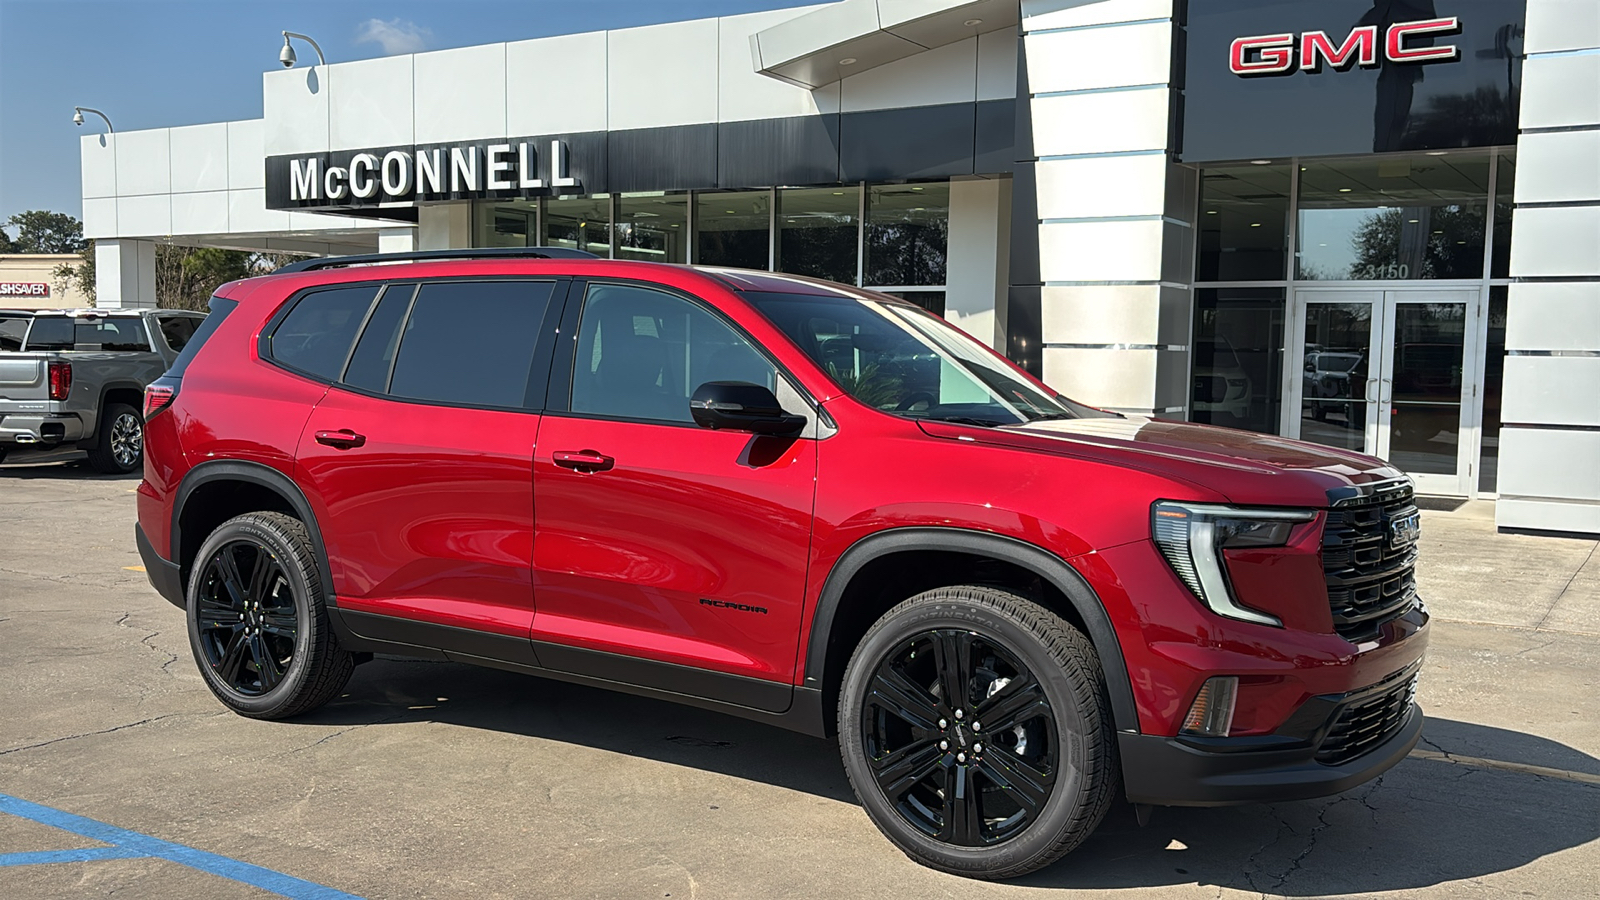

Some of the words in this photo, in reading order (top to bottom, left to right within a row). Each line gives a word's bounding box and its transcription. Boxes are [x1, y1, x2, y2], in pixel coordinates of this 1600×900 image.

[1229, 16, 1458, 75] GMC
[290, 140, 576, 200] McCONNELL
[1366, 264, 1409, 279] 3150
[0, 283, 45, 295] SHSAVER
[239, 526, 290, 567] CONTINENTAL
[699, 598, 768, 615] ACADIA
[900, 611, 1004, 634] CONTINENTAL
